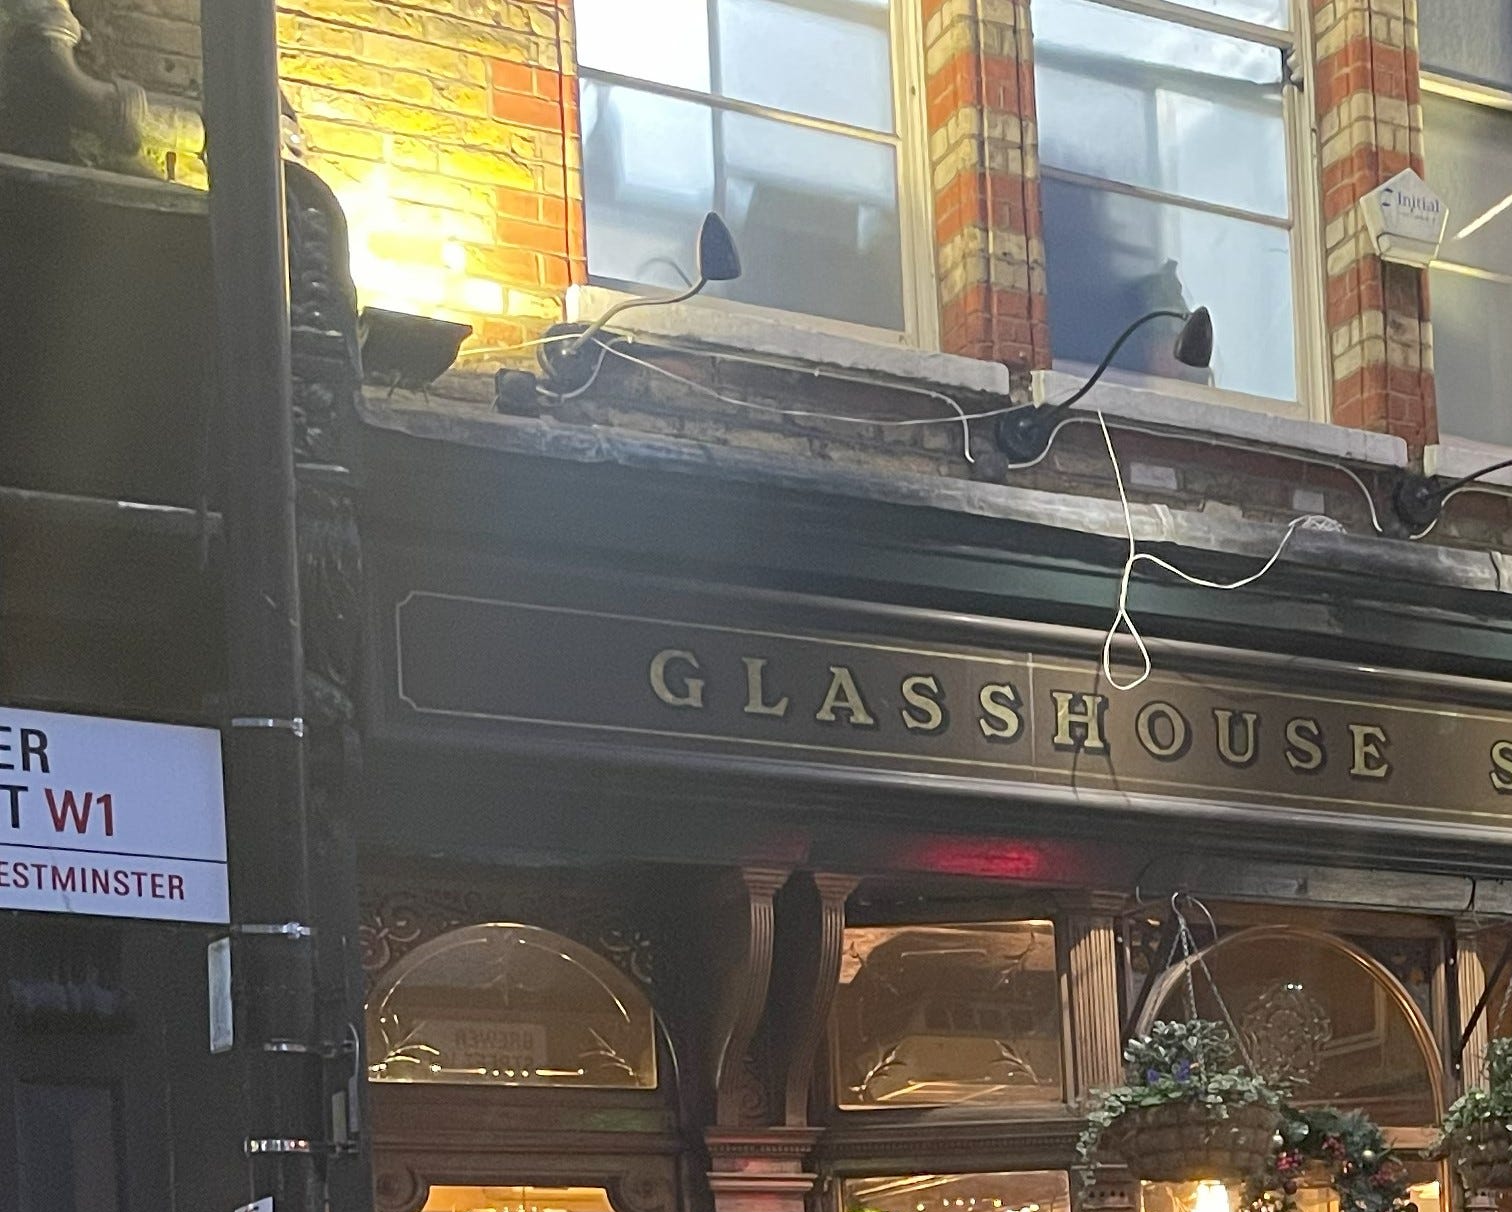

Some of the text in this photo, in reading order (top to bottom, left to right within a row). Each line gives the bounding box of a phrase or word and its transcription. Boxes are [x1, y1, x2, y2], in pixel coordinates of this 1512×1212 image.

[1397, 191, 1441, 214] Initial
[647, 648, 1391, 779] GLASSHOUSE
[44, 786, 114, 837] W1
